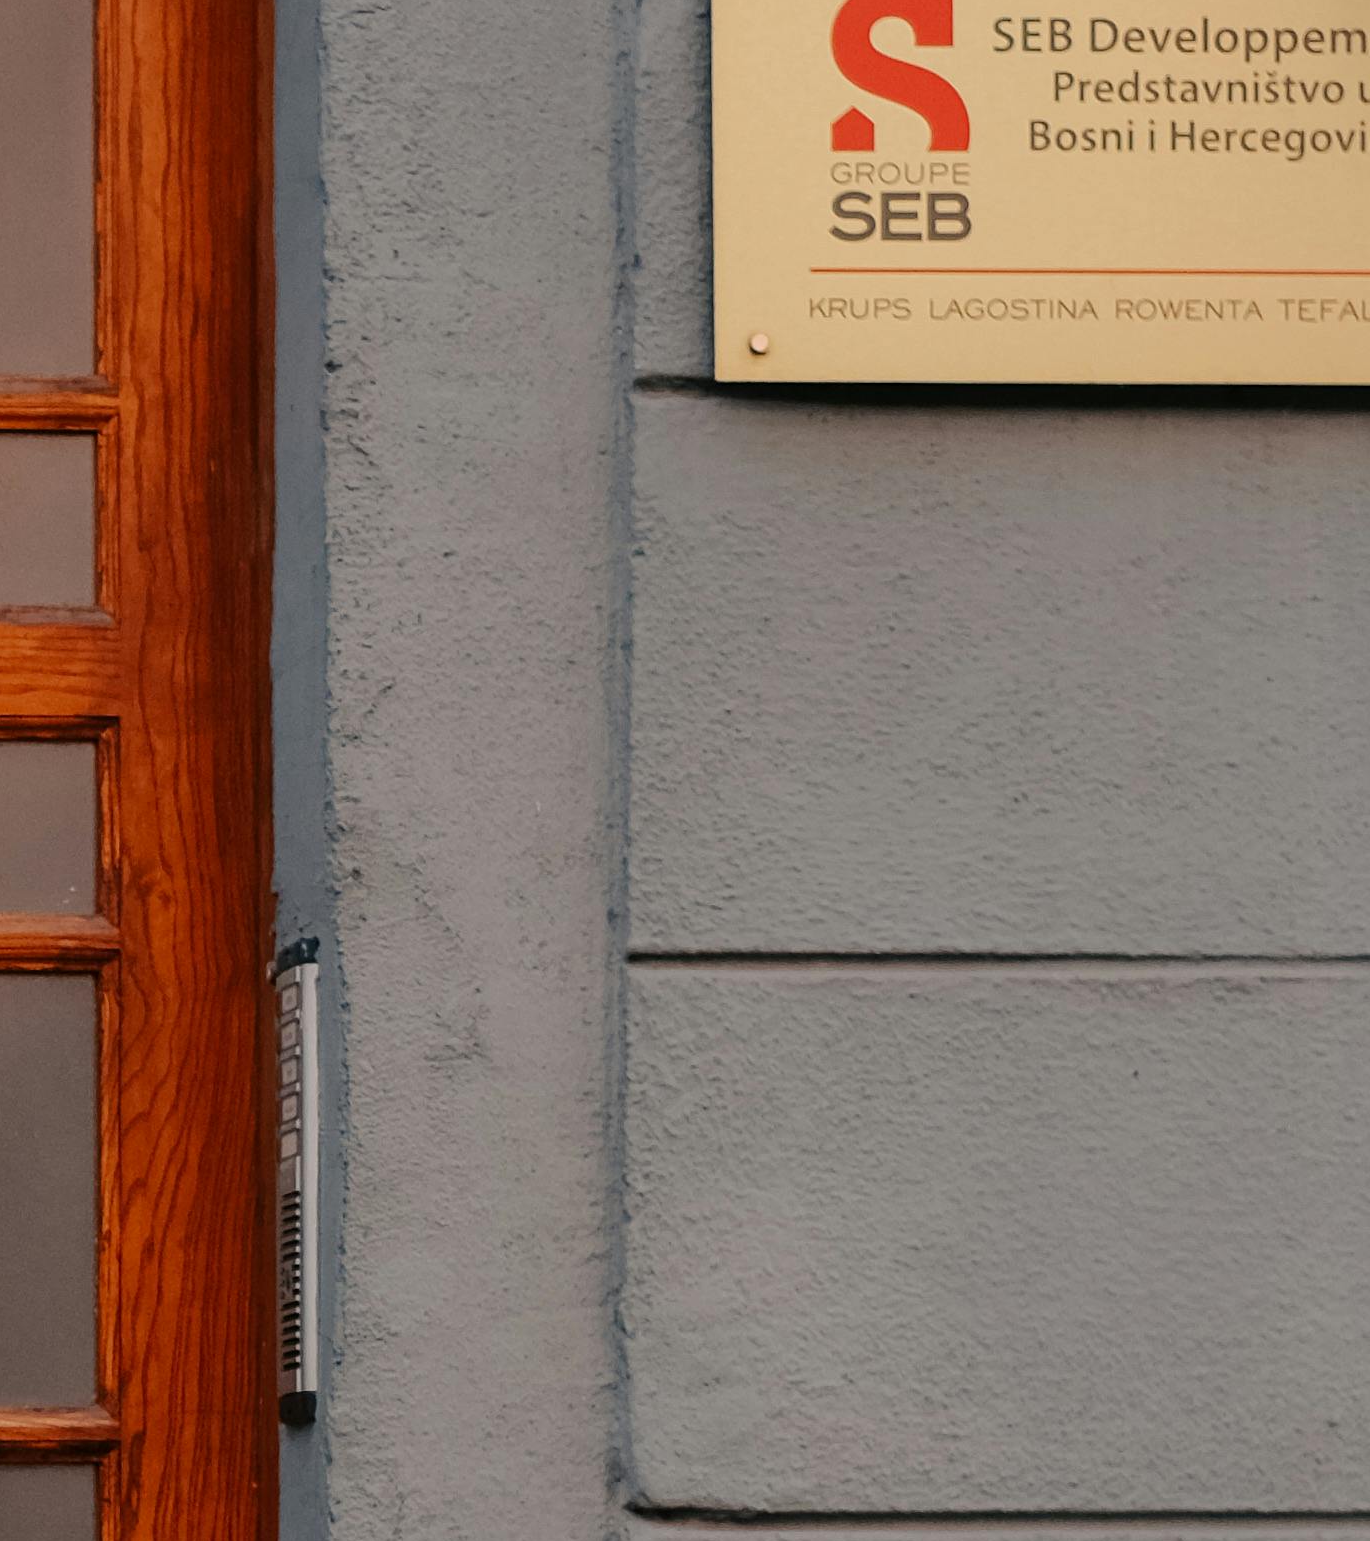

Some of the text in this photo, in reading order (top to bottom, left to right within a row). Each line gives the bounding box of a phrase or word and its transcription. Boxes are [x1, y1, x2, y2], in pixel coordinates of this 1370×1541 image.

[992, 16, 1368, 63] SEB Developpem
[1053, 71, 1345, 104] Predstavništvo
[1029, 120, 1367, 162] Bosni i Hercegovi
[830, 161, 971, 186] GROUPE
[830, 191, 972, 242] SEB
[808, 296, 913, 321] KRUPS
[929, 297, 1099, 322] LAGOSTINA
[1115, 298, 1264, 322] ROWENTA
